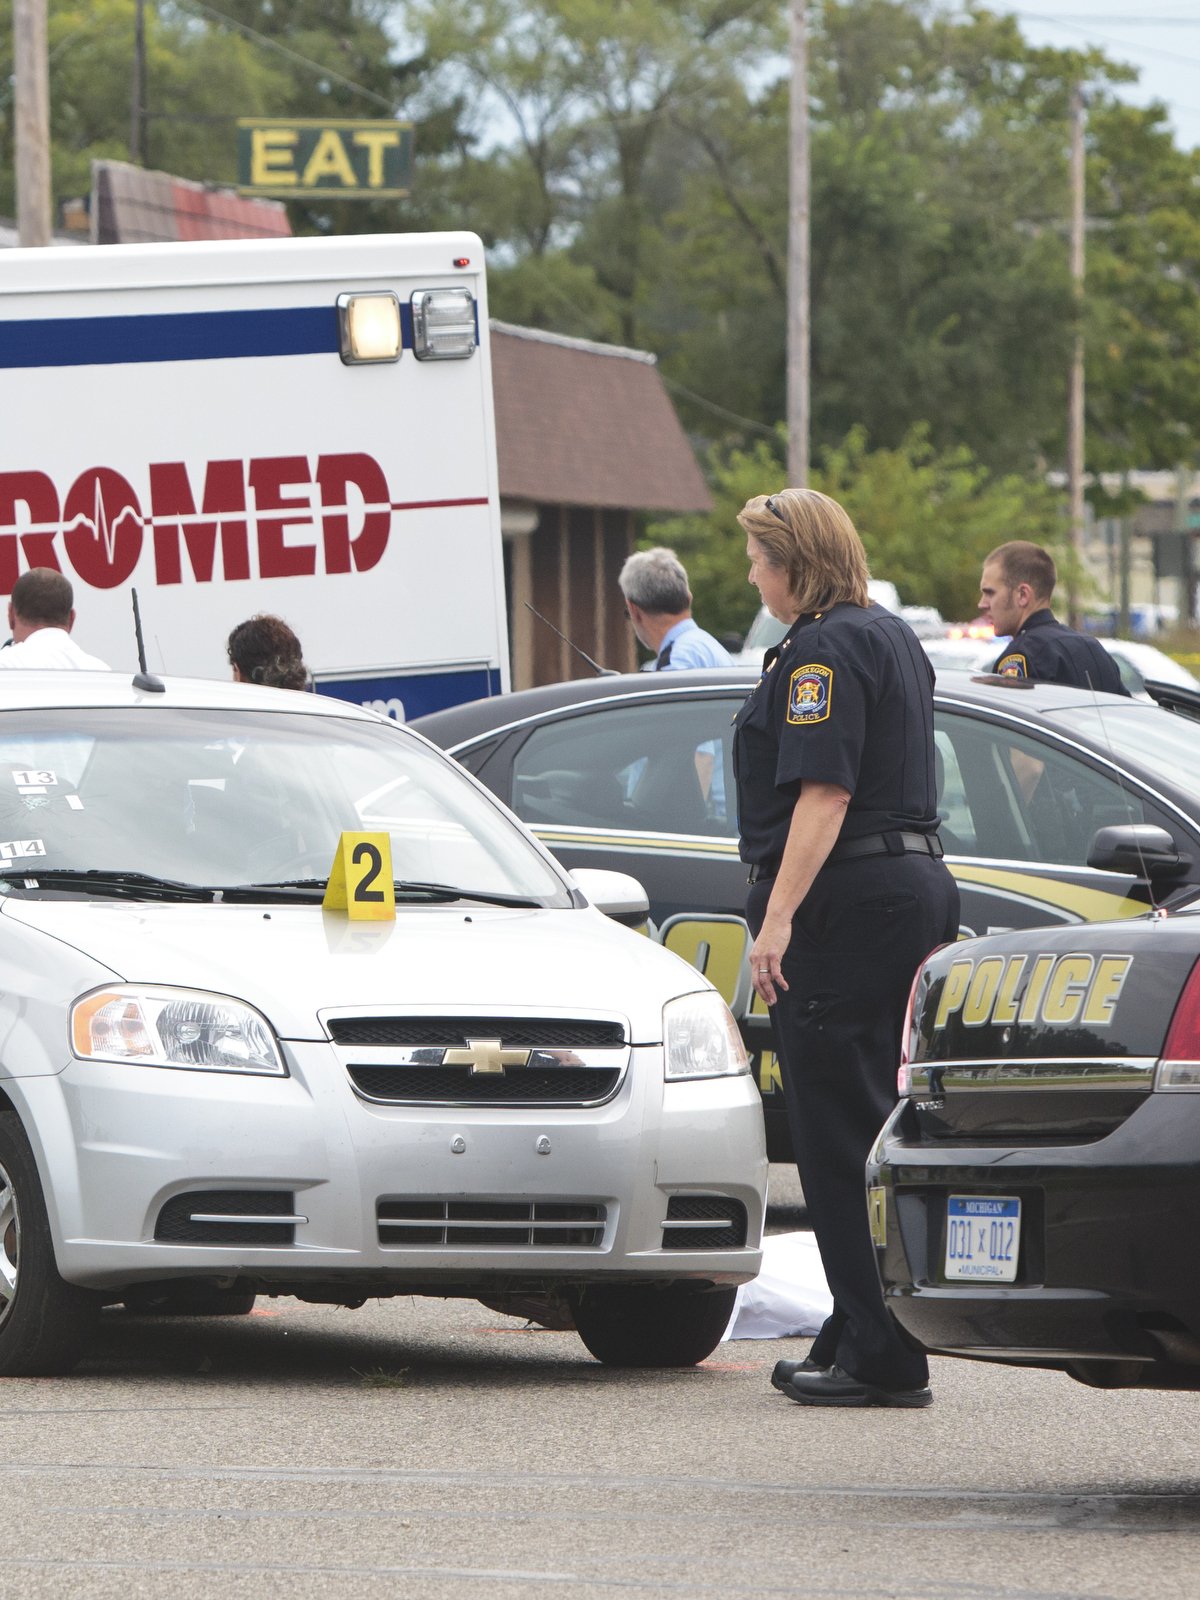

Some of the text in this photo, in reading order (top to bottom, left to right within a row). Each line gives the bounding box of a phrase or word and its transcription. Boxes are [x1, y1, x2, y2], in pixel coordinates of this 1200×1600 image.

[252, 129, 399, 187] EAT
[792, 713, 821, 721] POLICE
[18, 771, 55, 784] 13
[4, 841, 43, 857] 14
[352, 842, 385, 903] 2
[934, 953, 1135, 1031] POLICE
[965, 1201, 1004, 1214] MICHIGAN
[949, 1220, 973, 1259] 031
[989, 1221, 1014, 1262] 012
[961, 1264, 1000, 1276] MUNICIPAL
